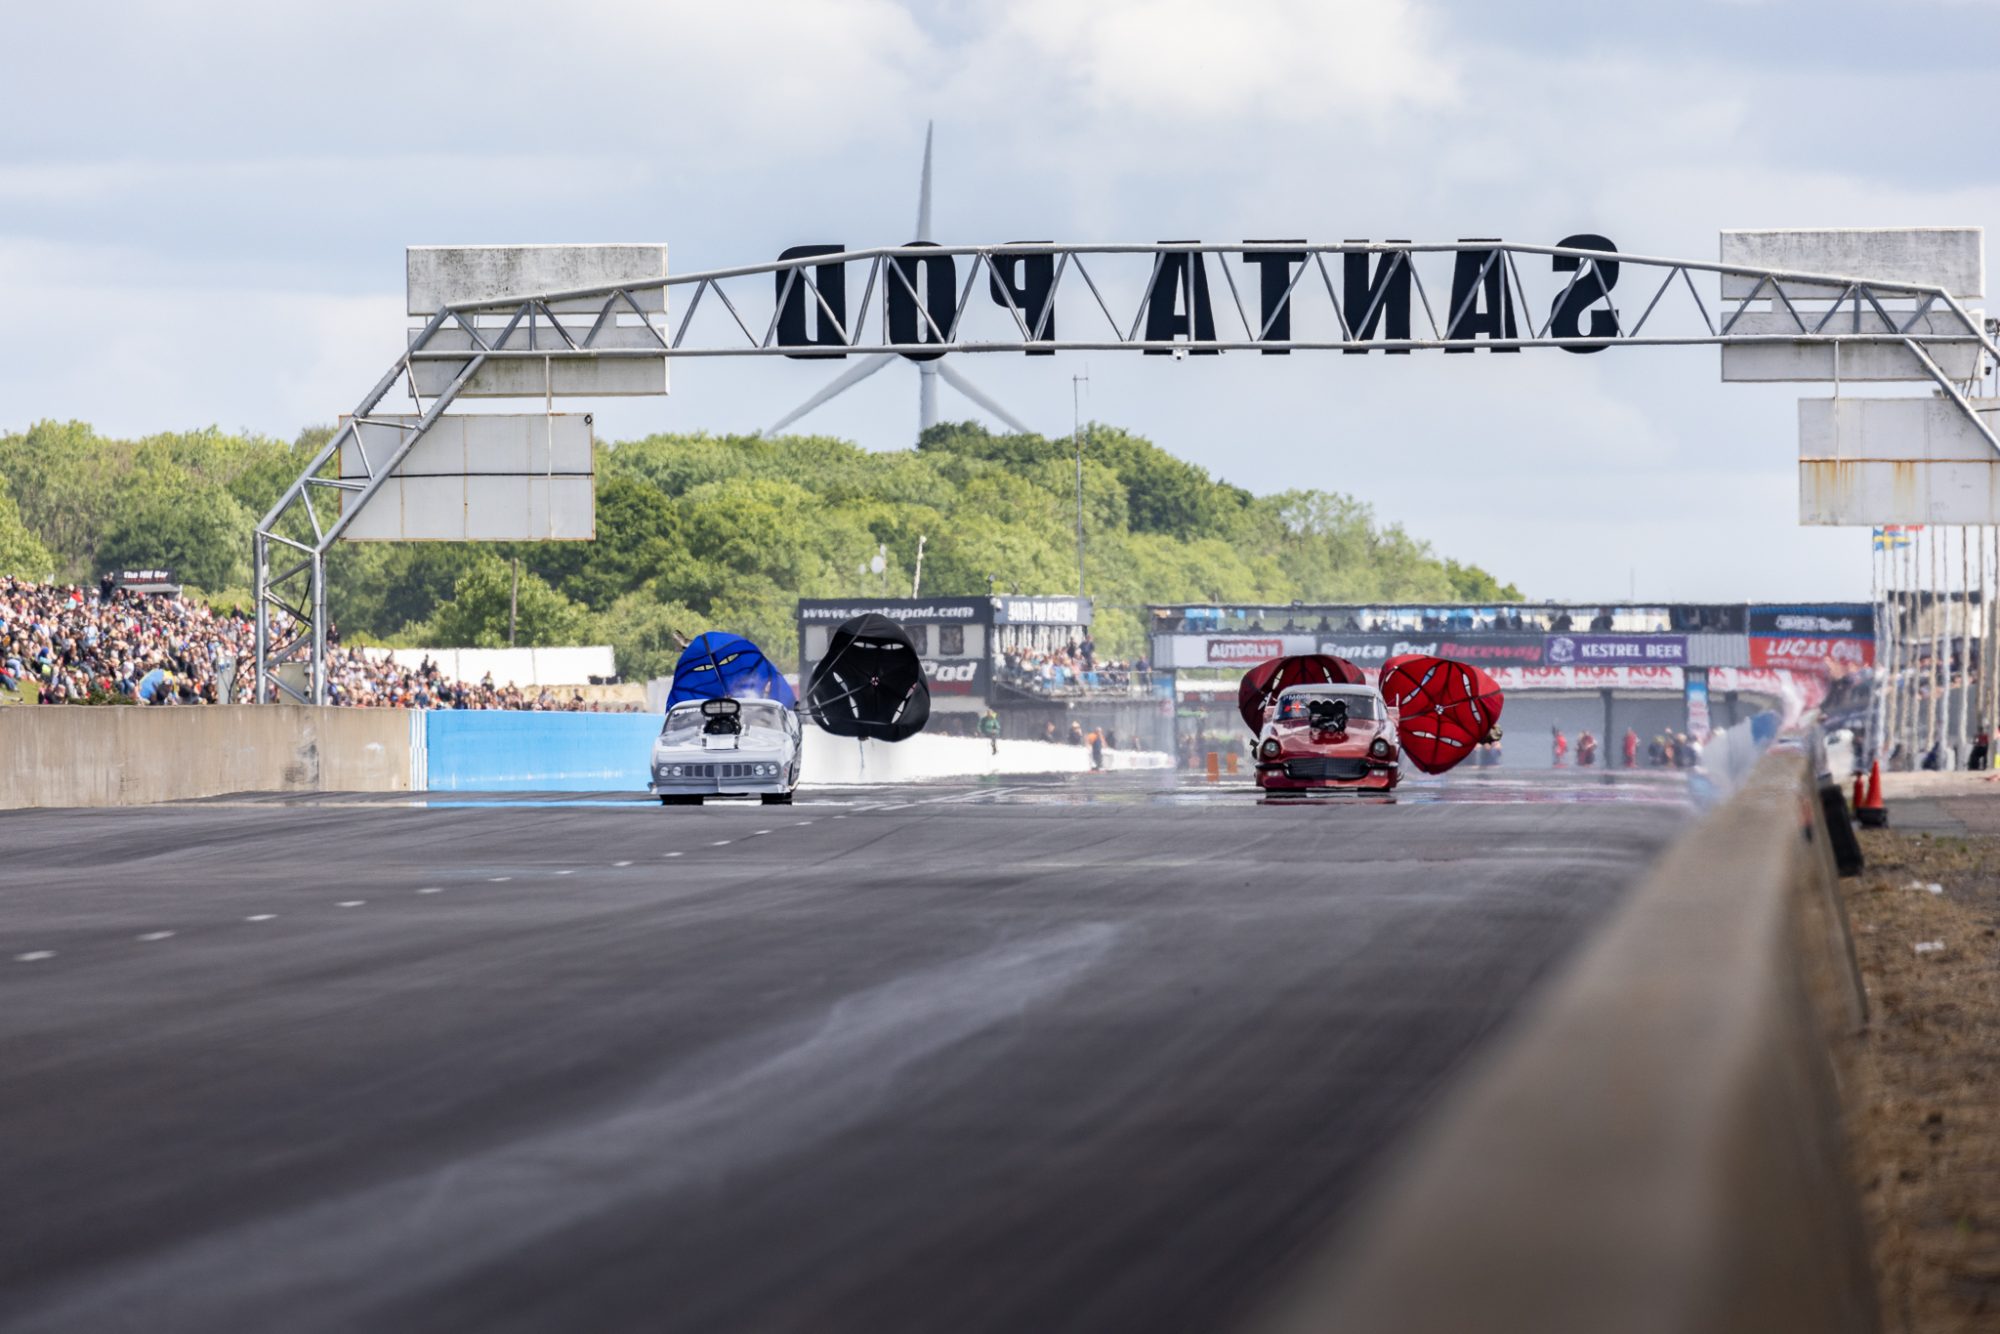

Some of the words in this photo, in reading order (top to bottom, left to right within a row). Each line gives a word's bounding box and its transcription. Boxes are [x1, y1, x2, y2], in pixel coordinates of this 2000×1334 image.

[1320, 642, 1387, 658] Santa
[1581, 643, 1642, 658] KESTREL
[1646, 643, 1682, 658] BEER
[1766, 639, 1827, 657] LUCAS
